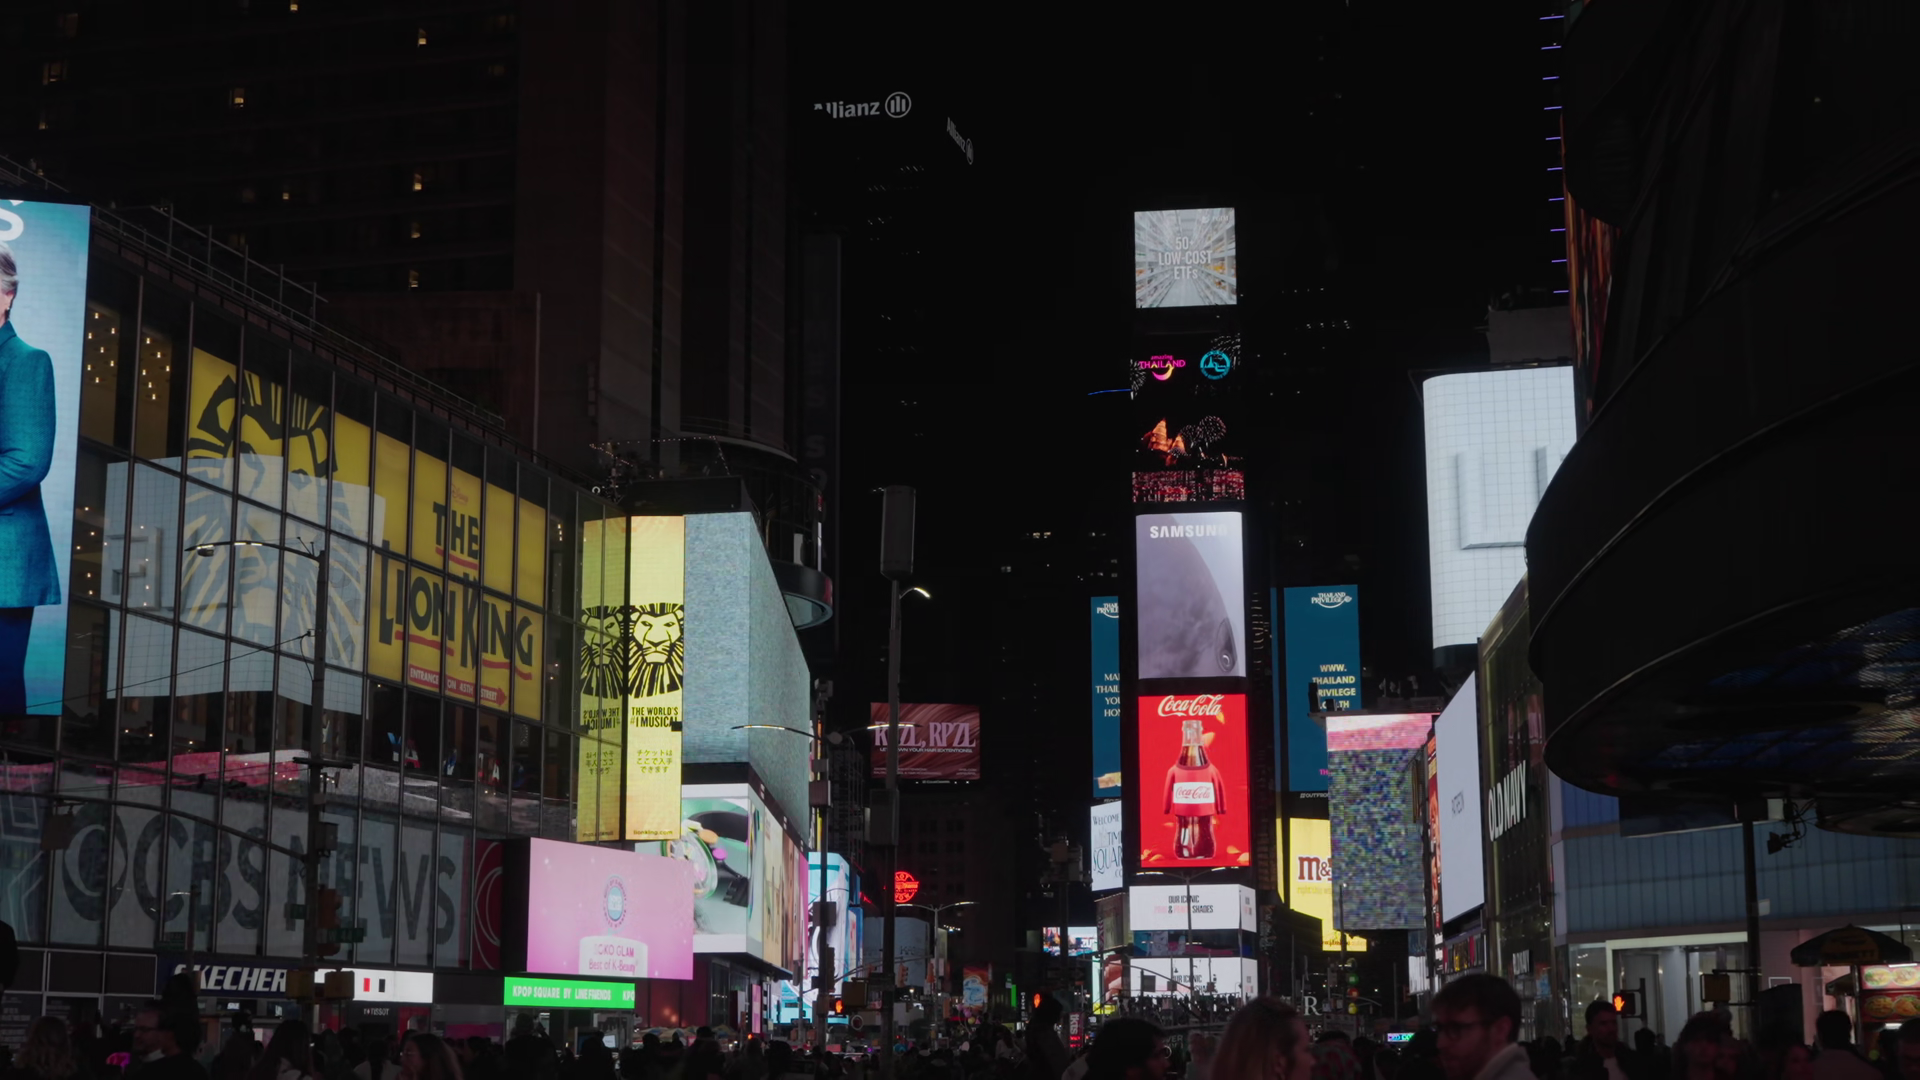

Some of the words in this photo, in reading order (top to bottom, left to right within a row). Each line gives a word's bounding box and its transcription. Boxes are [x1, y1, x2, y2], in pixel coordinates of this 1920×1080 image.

[1158, 250, 1212, 266] LOW-COST
[1173, 265, 1199, 280] ETFs
[1138, 359, 1186, 370] THAILAND
[433, 501, 480, 560] THE
[378, 539, 456, 646] LION
[460, 571, 534, 671] KING
[1311, 596, 1343, 604] PRIVILEGE
[1319, 664, 1347, 672] WWW.
[410, 667, 439, 685] ENTRANCE
[447, 678, 457, 690] ON
[480, 688, 498, 701] STREET
[1312, 676, 1356, 685] THAILAND
[1317, 688, 1356, 697] RIVILEGE
[631, 707, 644, 716] THE
[647, 706, 679, 716] WORLD'S
[1158, 694, 1224, 717] Coca-Cola
[928, 722, 977, 748] RPZL
[1175, 786, 1212, 799] Coca-Cola
[1488, 782, 1504, 842] OLD
[1503, 759, 1527, 832] NAVY
[1092, 813, 1120, 826] WELCOME
[133, 815, 270, 932] CBS
[1168, 896, 1181, 904] OUR
[1180, 896, 1200, 904] ICNIC
[1192, 905, 1214, 914] SHADES
[616, 945, 635, 958] GLAM
[603, 959, 611, 970] of
[174, 963, 288, 993] KECHER
[512, 985, 532, 997] KPOP
[533, 987, 561, 998] SQUARE
[563, 988, 572, 999] BY
[371, 1008, 390, 1016] TISSOT
